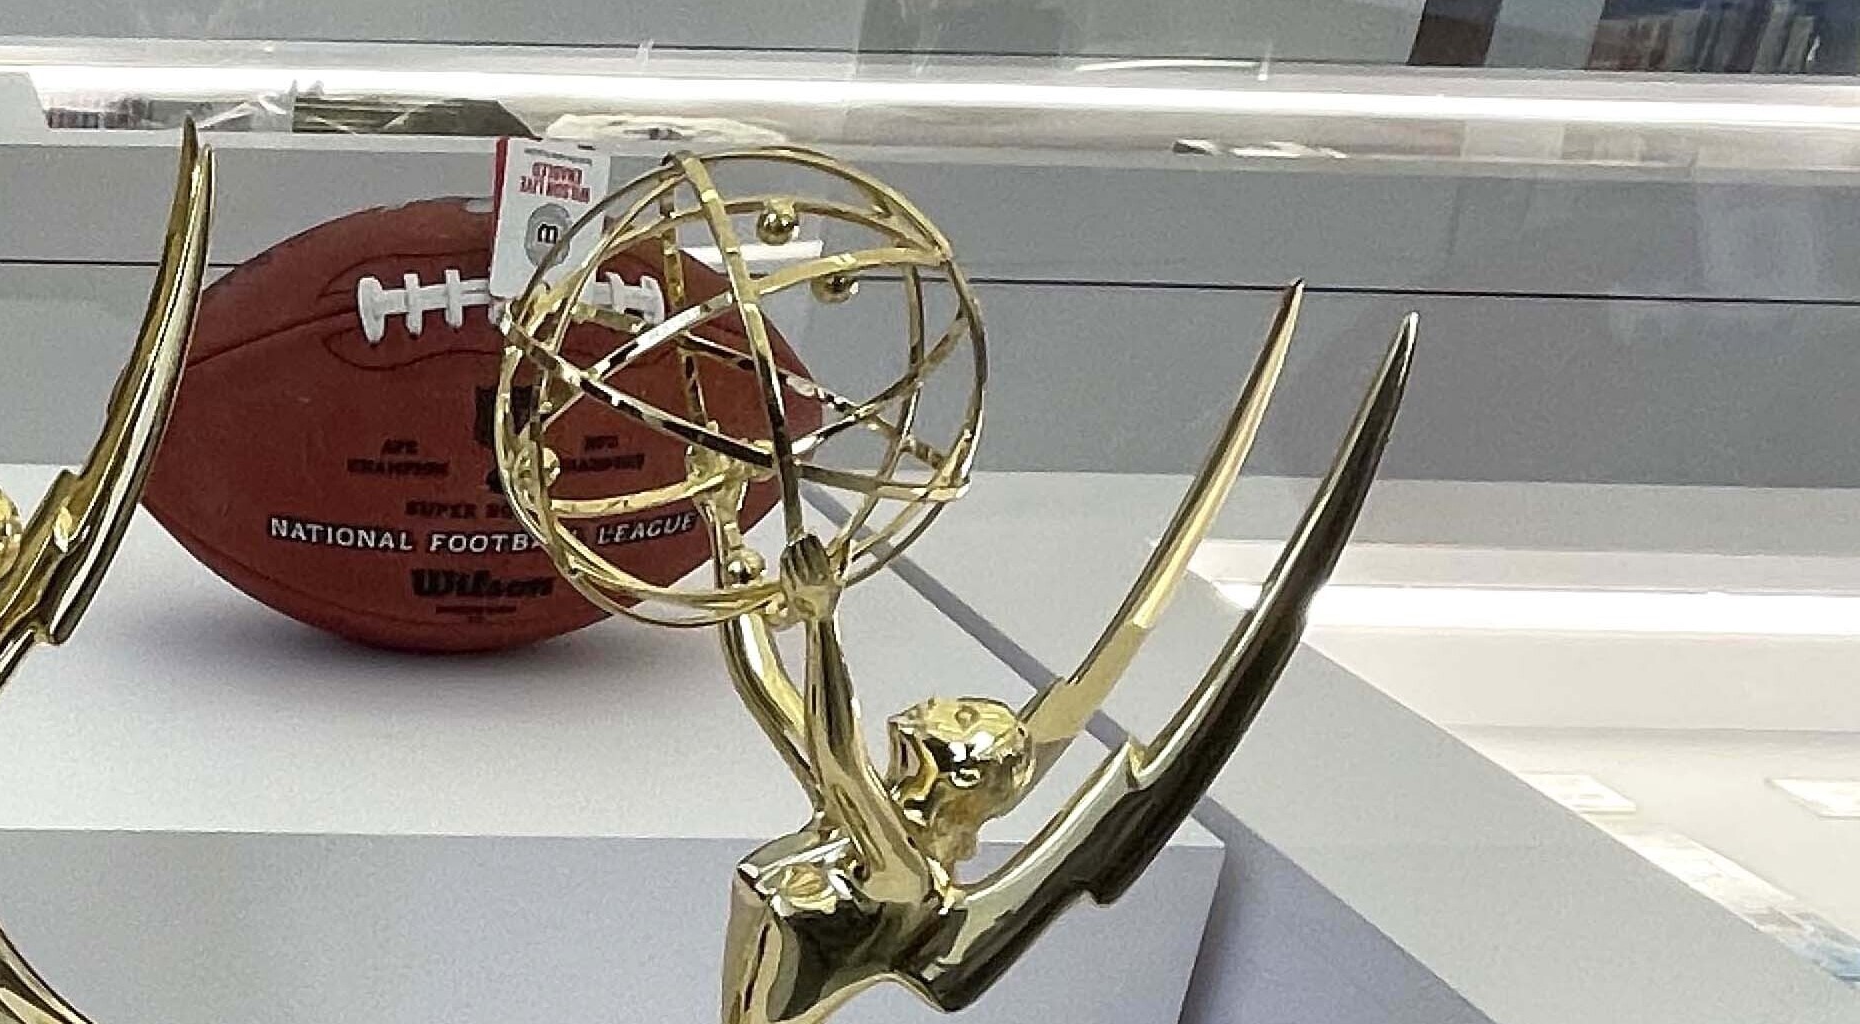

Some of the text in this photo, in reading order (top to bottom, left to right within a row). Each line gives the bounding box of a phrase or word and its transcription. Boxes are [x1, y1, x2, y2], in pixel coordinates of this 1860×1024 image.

[269, 516, 413, 551] NATIONAL
[597, 511, 699, 546] LEAGUE
[410, 568, 558, 597] Wilson
